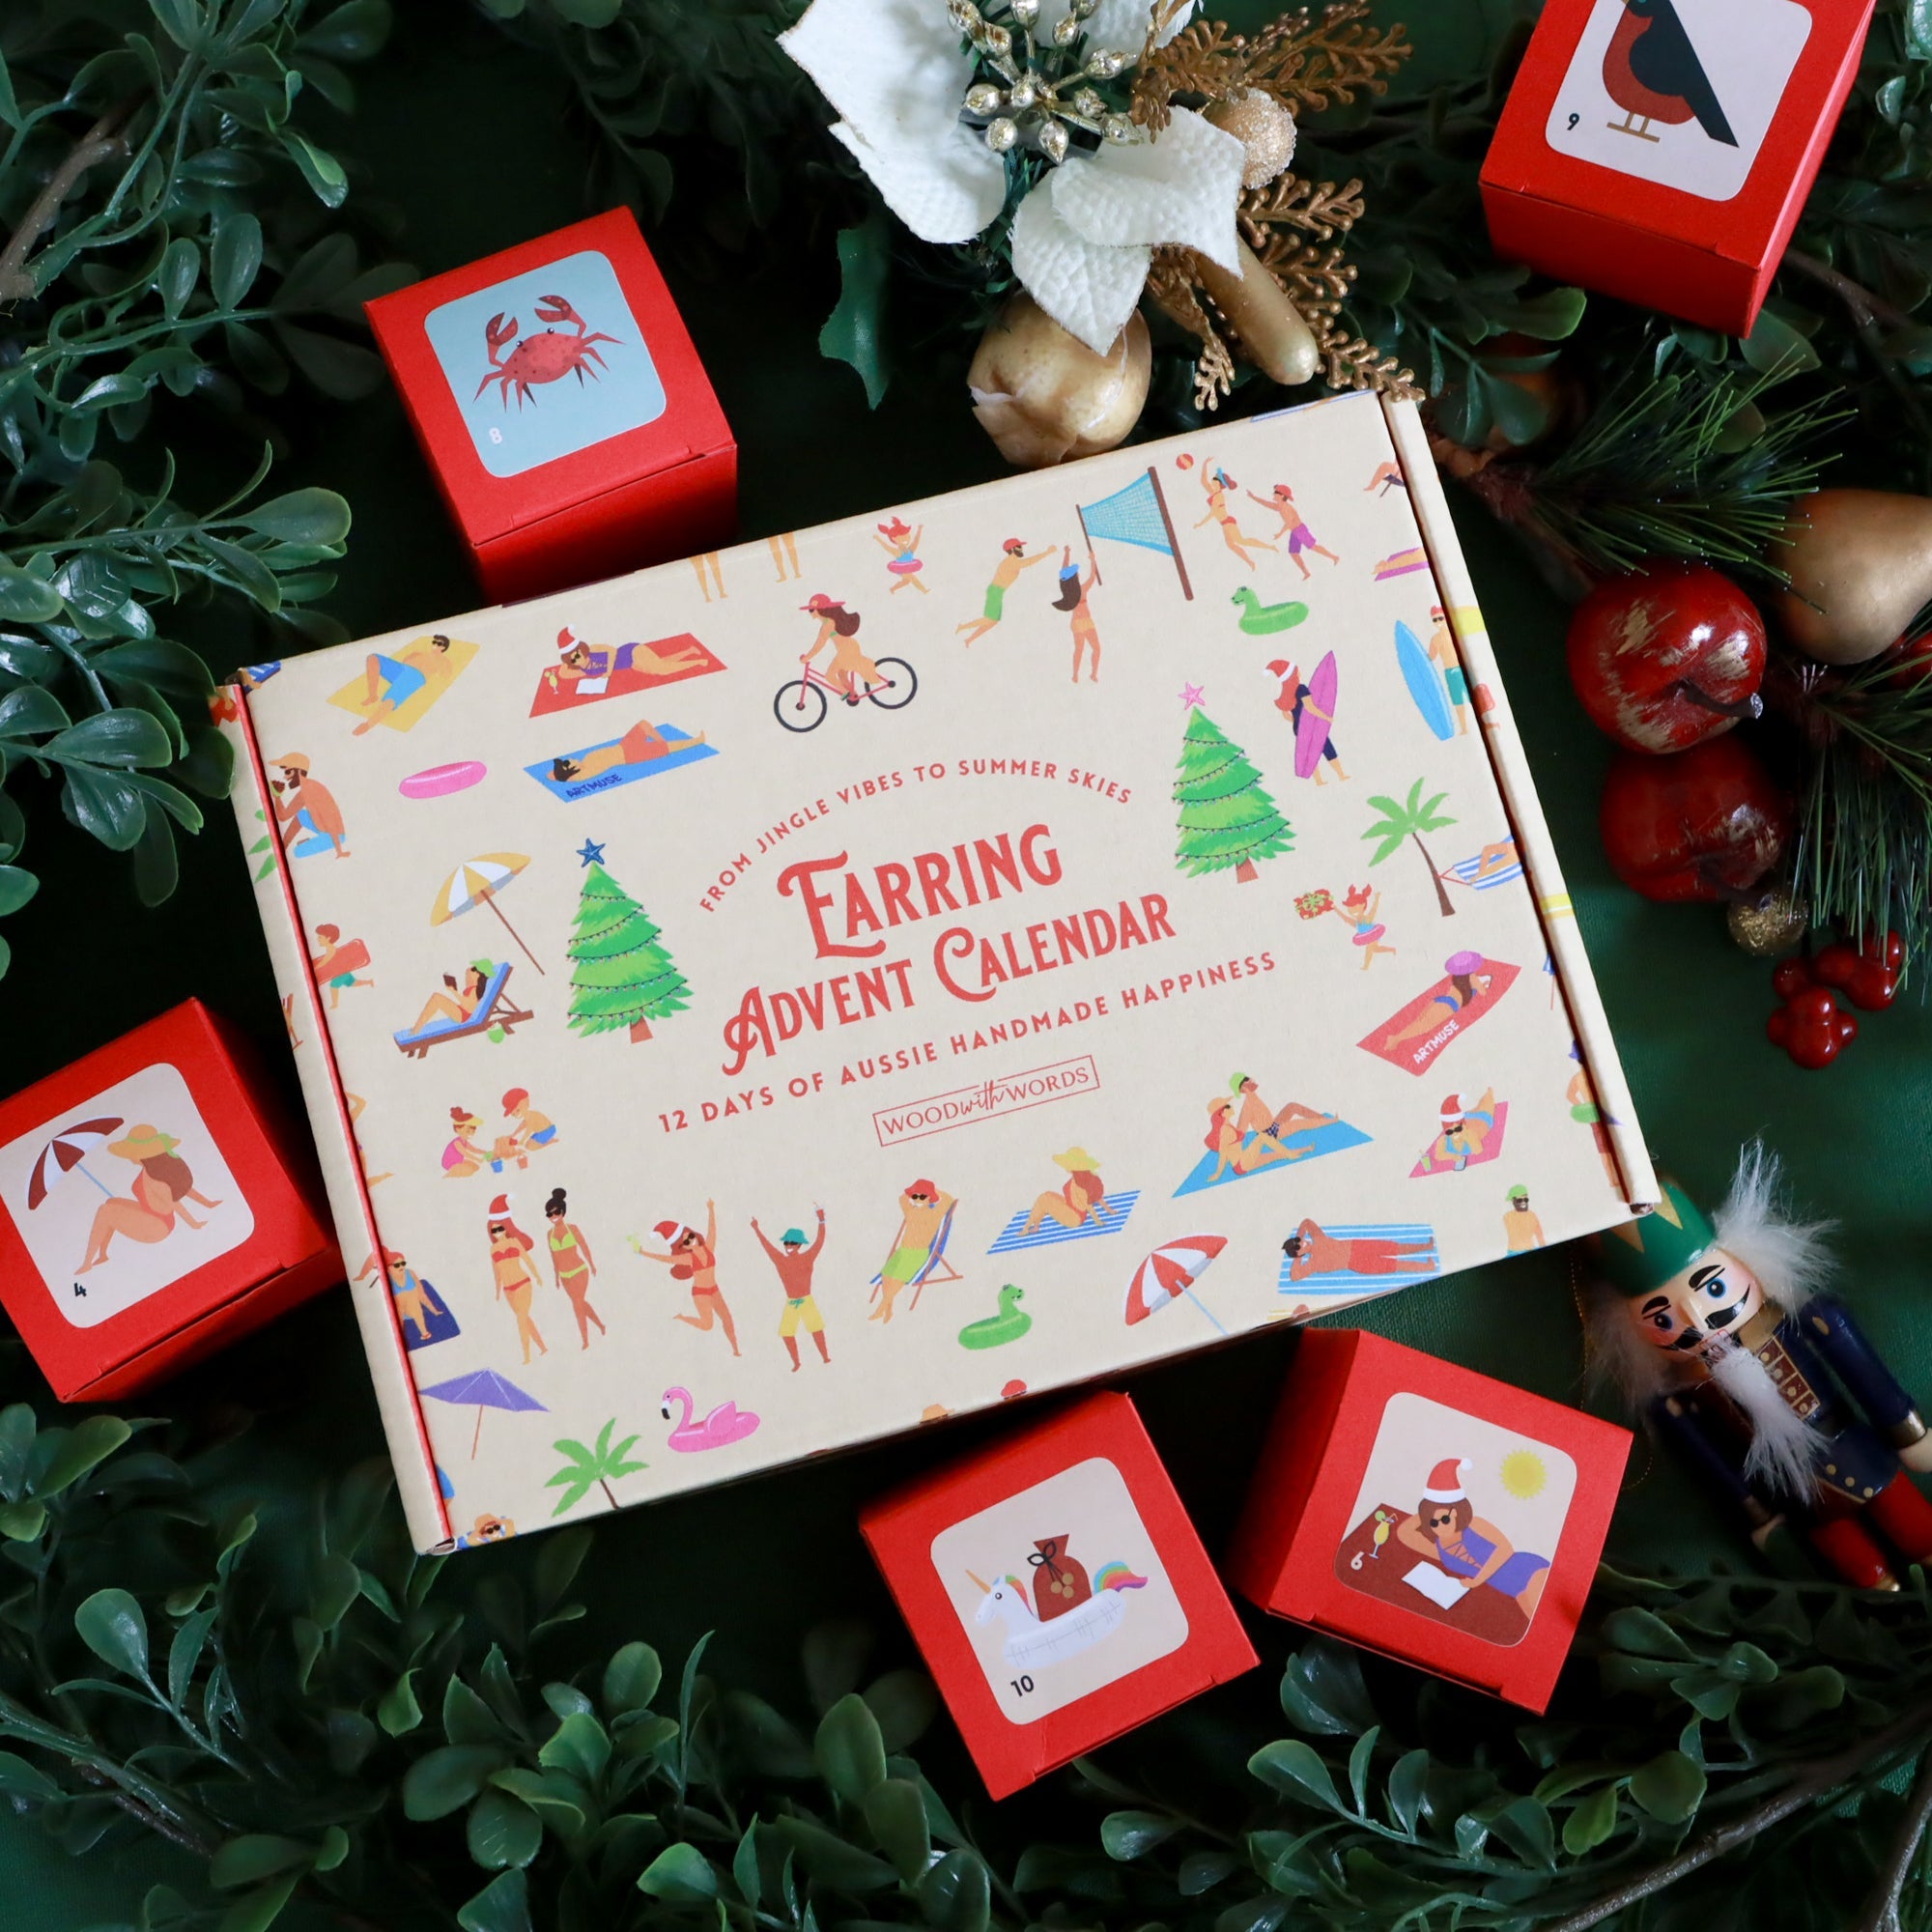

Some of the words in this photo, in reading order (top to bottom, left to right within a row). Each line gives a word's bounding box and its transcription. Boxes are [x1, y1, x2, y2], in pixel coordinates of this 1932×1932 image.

[1567, 112, 1579, 130] 9
[489, 427, 502, 444] 8
[566, 774, 623, 798] ARTMUSE
[699, 853, 753, 912] FROM
[757, 799, 830, 854] JINGLE
[837, 772, 903, 804] VIBES
[913, 762, 947, 781] TO
[958, 759, 1058, 780] SUMMER
[1068, 768, 1131, 804] SKIES
[659, 1110, 689, 1133] 12
[700, 1086, 775, 1122] DAYS
[788, 1071, 824, 1098] OF
[840, 1042, 938, 1085] AUSSIE
[951, 996, 1109, 1055] HANDMADE
[1122, 952, 1275, 1009] HAPPINESS
[1413, 1019, 1460, 1064] ARTMUSE
[73, 1282, 87, 1297] 4
[1350, 1550, 1365, 1571] 6
[1010, 1675, 1035, 1697] 10
